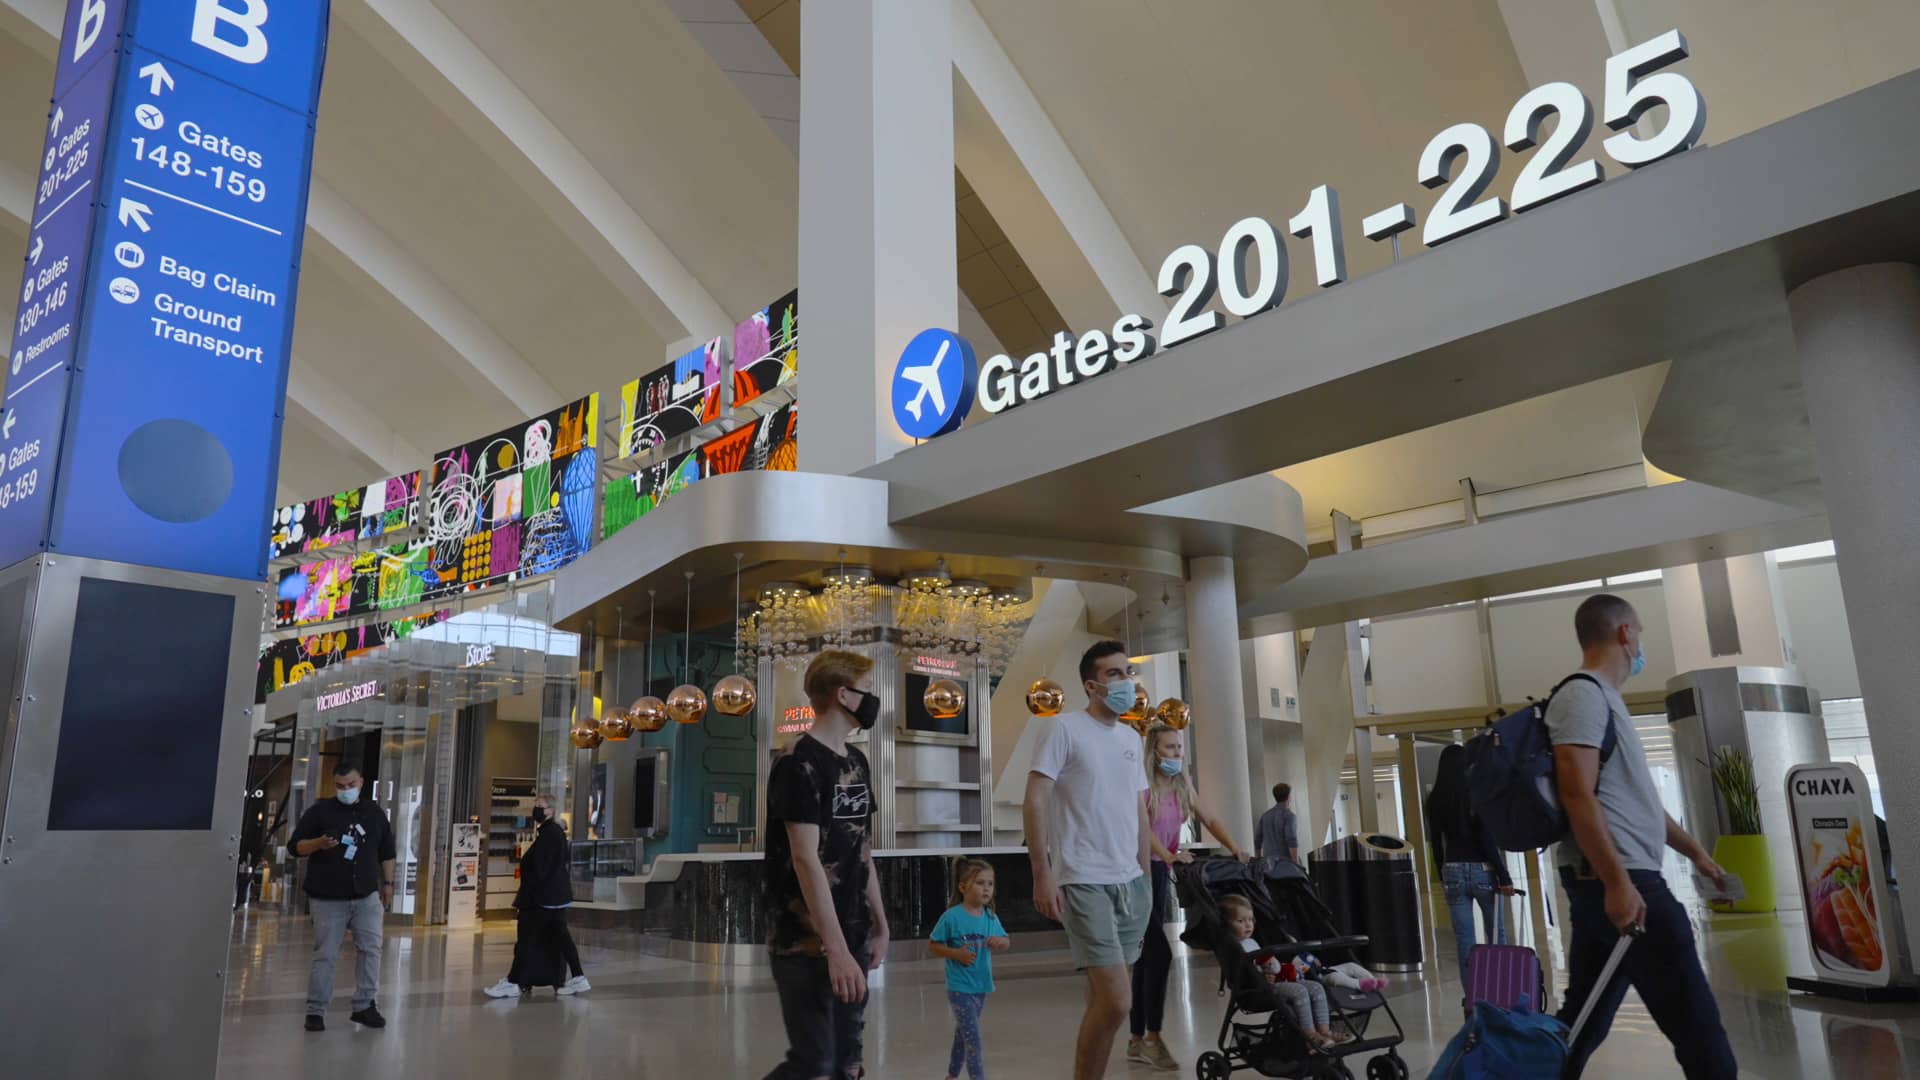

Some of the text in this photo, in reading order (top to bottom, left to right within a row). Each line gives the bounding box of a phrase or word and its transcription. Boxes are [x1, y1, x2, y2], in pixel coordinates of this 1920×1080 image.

[73, 0, 107, 64] B
[191, 0, 268, 64] B
[58, 119, 90, 158] Gates
[177, 120, 263, 169] Gates
[38, 142, 88, 205] 201-225
[131, 136, 266, 203] 148-159
[976, 28, 1702, 414] Gates 201-225
[37, 255, 69, 291] Gates
[159, 255, 276, 306] Bag Claim
[19, 281, 67, 336] 130-146
[154, 293, 241, 332] Ground
[25, 323, 70, 363] Restrooms
[151, 316, 263, 363] Transport
[8, 439, 40, 471] Gates
[351, 679, 377, 702] SECRET
[1796, 777, 1855, 796] CHAYA
